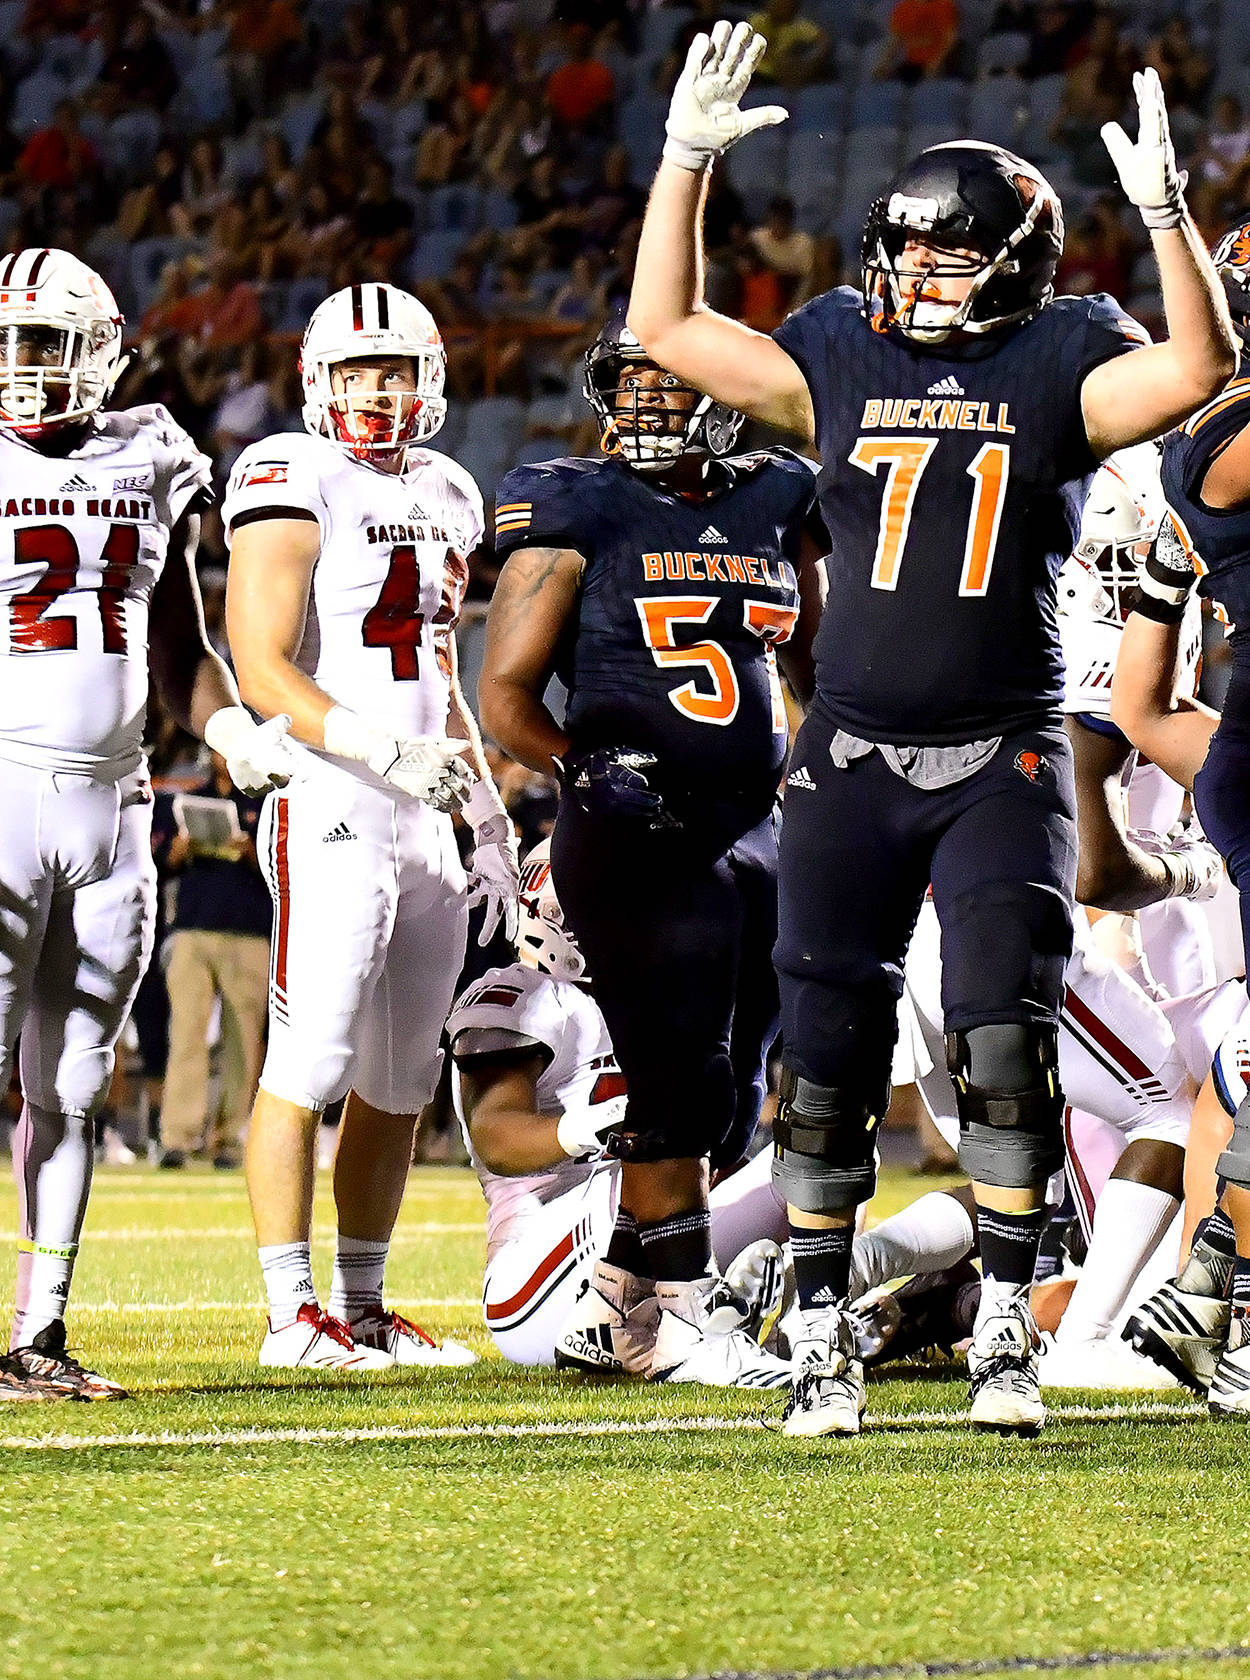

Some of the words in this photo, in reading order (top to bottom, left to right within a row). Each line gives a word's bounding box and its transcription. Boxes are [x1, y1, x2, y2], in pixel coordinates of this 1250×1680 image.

[927, 386, 965, 396] adidas
[860, 398, 1016, 434] BUCKNELL
[113, 475, 149, 490] NEC
[0, 498, 75, 518] ACRED
[86, 499, 151, 519] HEART
[848, 436, 1010, 597] 71
[698, 536, 729, 544] adidas
[642, 551, 797, 592] BUCKNELL
[9, 523, 140, 656] 21
[633, 595, 801, 733] 57
[786, 777, 817, 791] adidas
[322, 833, 359, 844] adidas
[564, 1334, 624, 1369] adidas
[986, 1341, 1023, 1351] adidas
[798, 1361, 833, 1374] adidas
